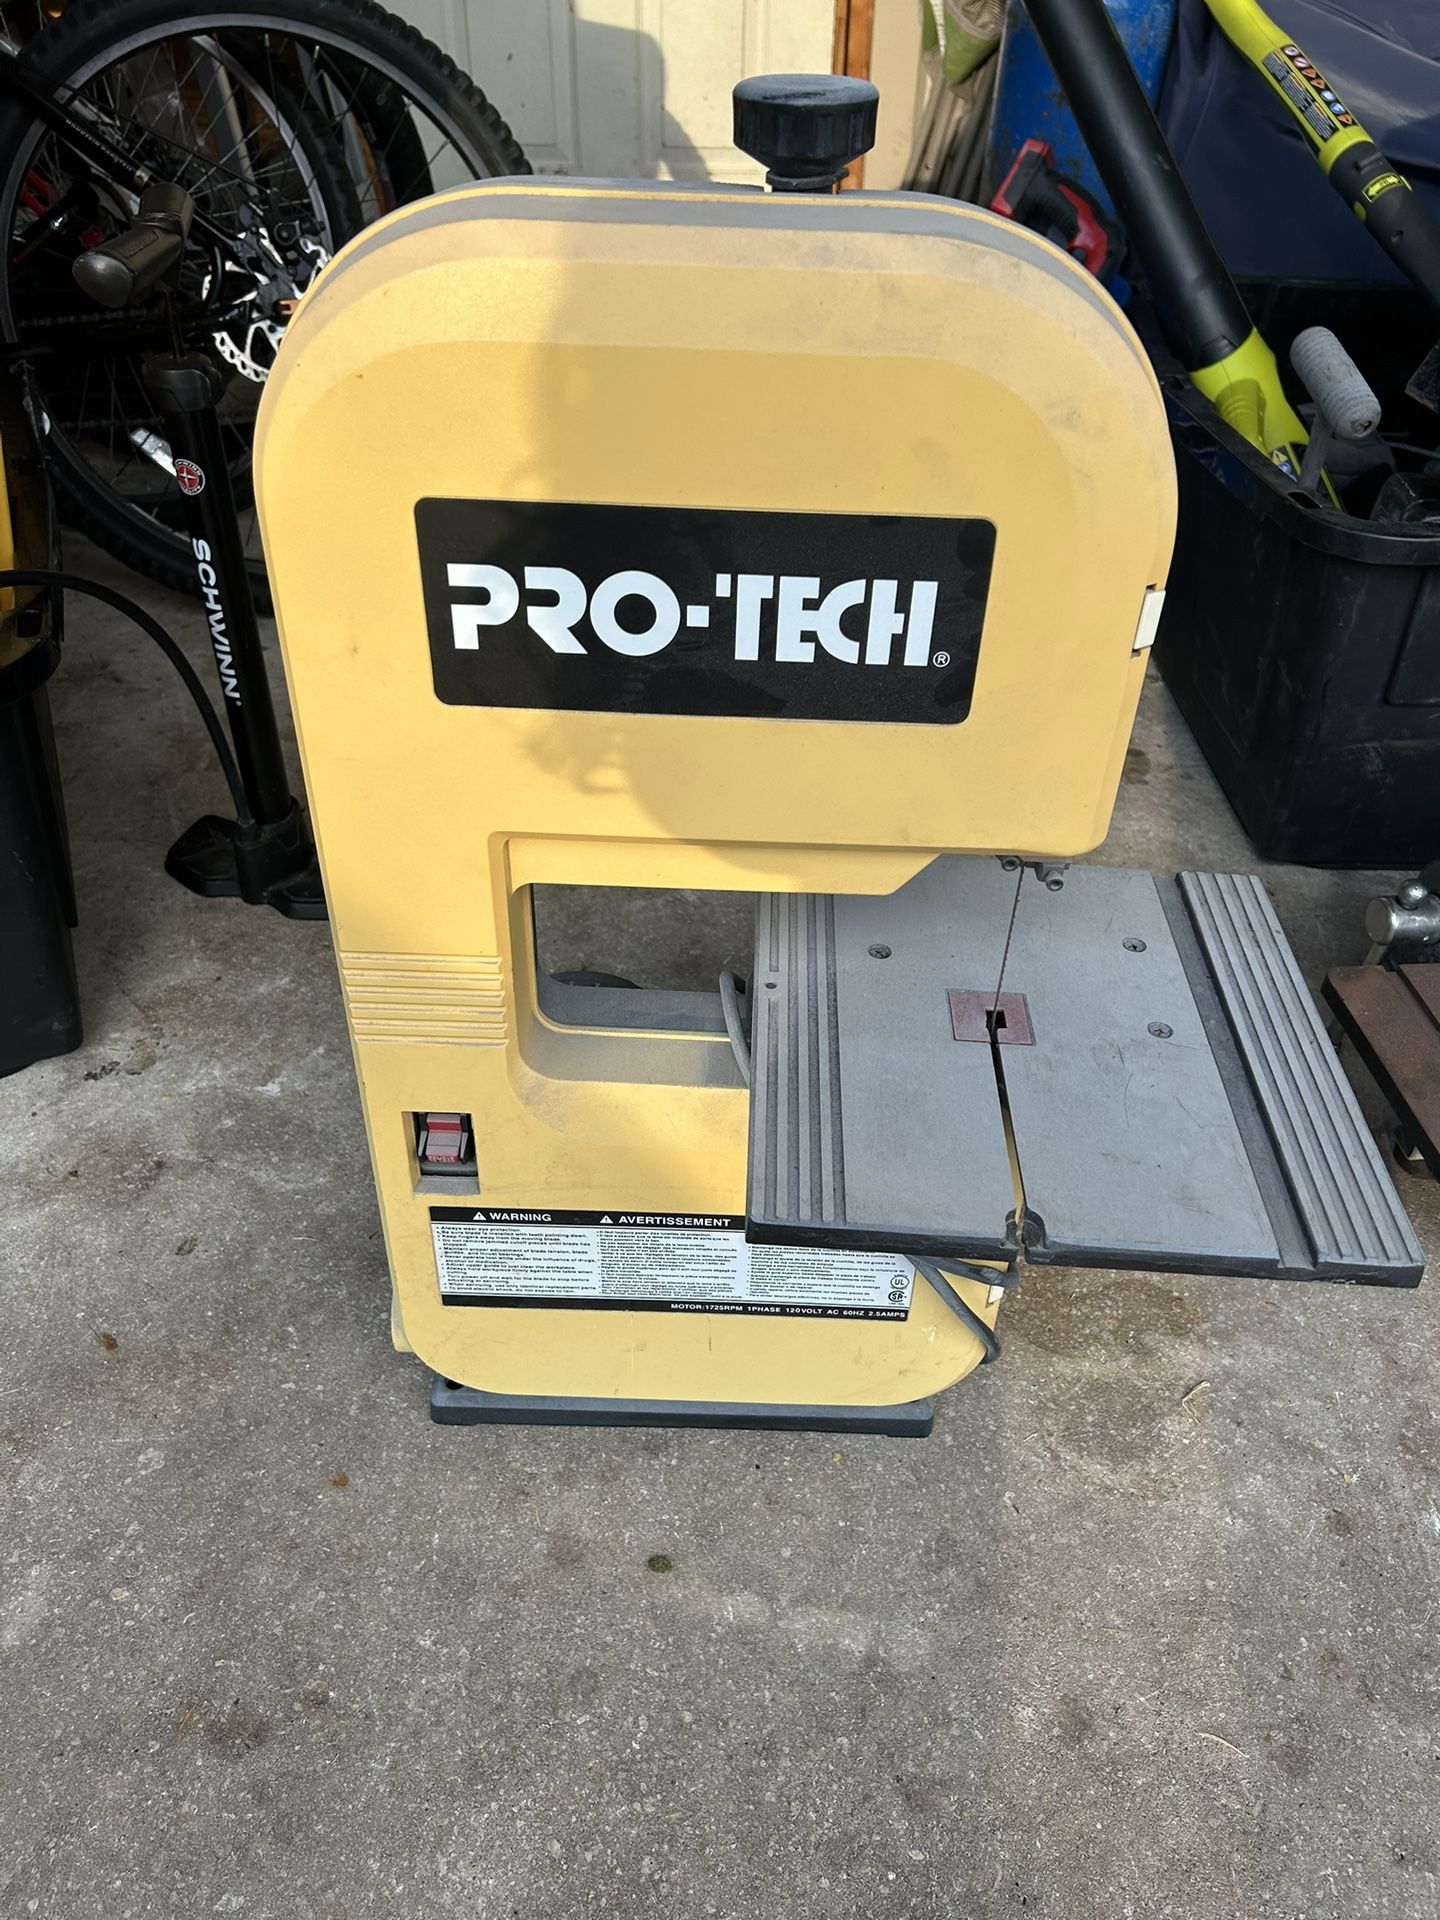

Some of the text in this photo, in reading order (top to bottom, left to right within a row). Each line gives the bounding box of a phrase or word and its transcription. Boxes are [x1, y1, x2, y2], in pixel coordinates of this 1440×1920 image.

[192, 538, 241, 699] SCHWINN
[489, 1212, 552, 1222] WARNING
[618, 1215, 732, 1227] AVERTISSEMENT
[785, 1307, 823, 1315] 120VOLT
